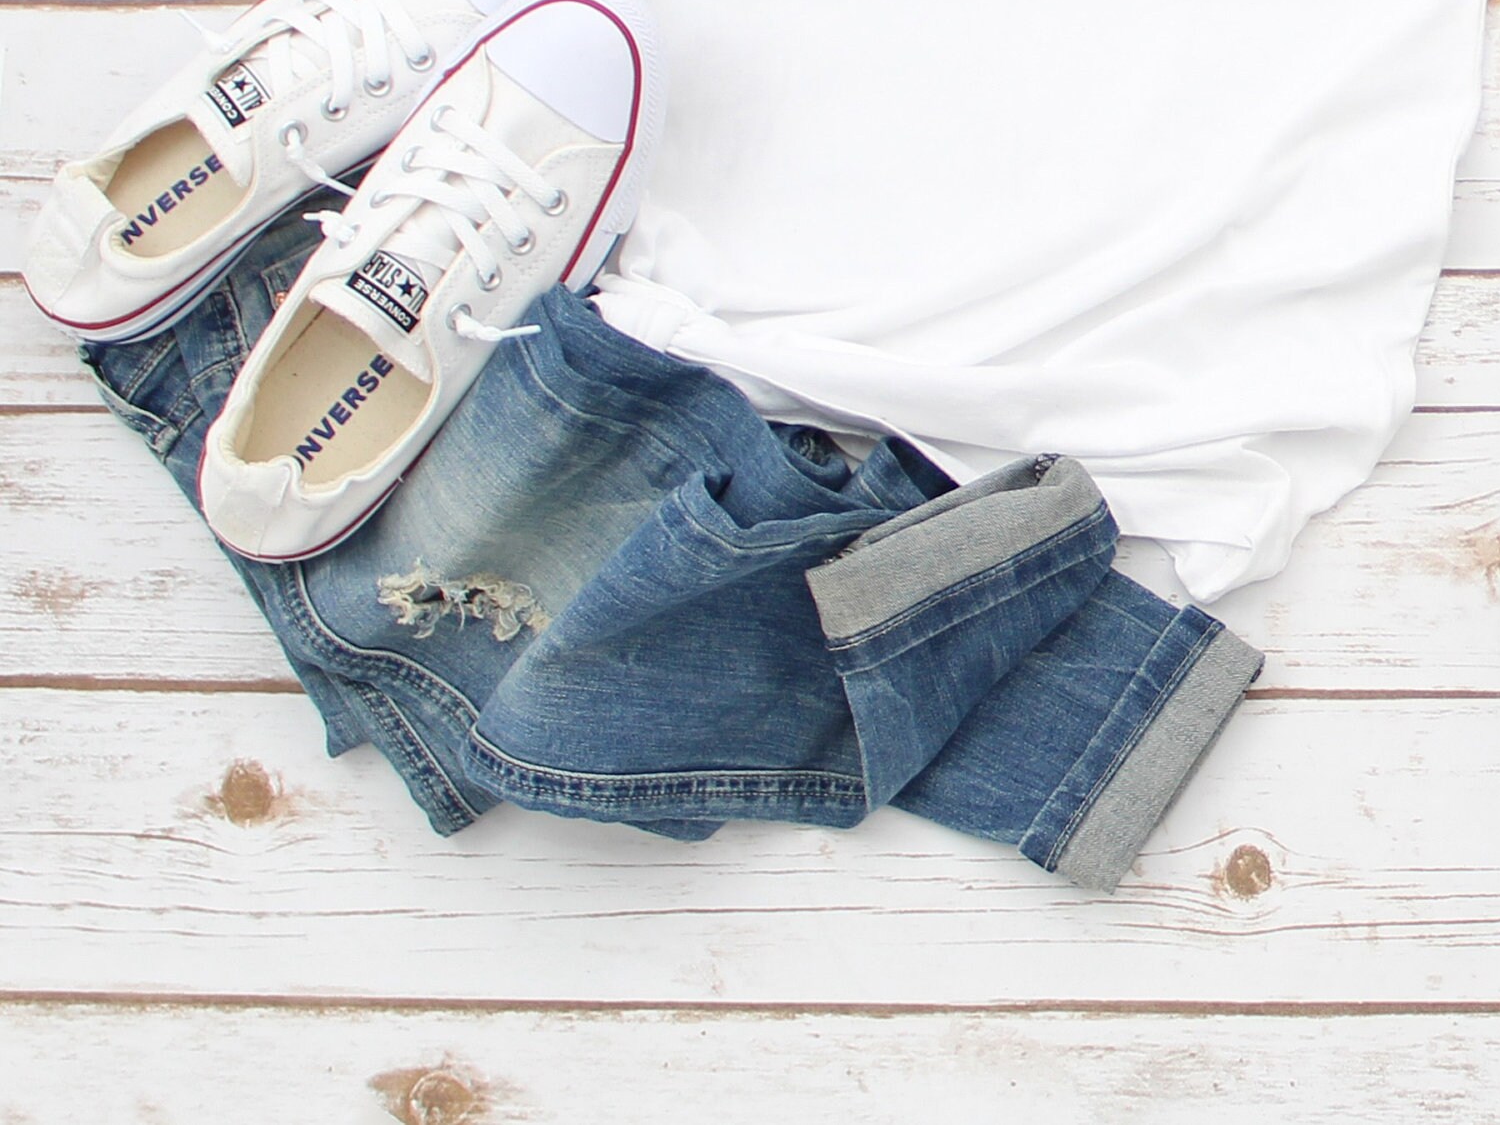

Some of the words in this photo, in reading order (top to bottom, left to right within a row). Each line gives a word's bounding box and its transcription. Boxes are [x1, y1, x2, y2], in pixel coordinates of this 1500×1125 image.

[363, 253, 402, 289] STAR
[353, 278, 412, 327] CONVERSE
[293, 354, 394, 473] NVERSE
